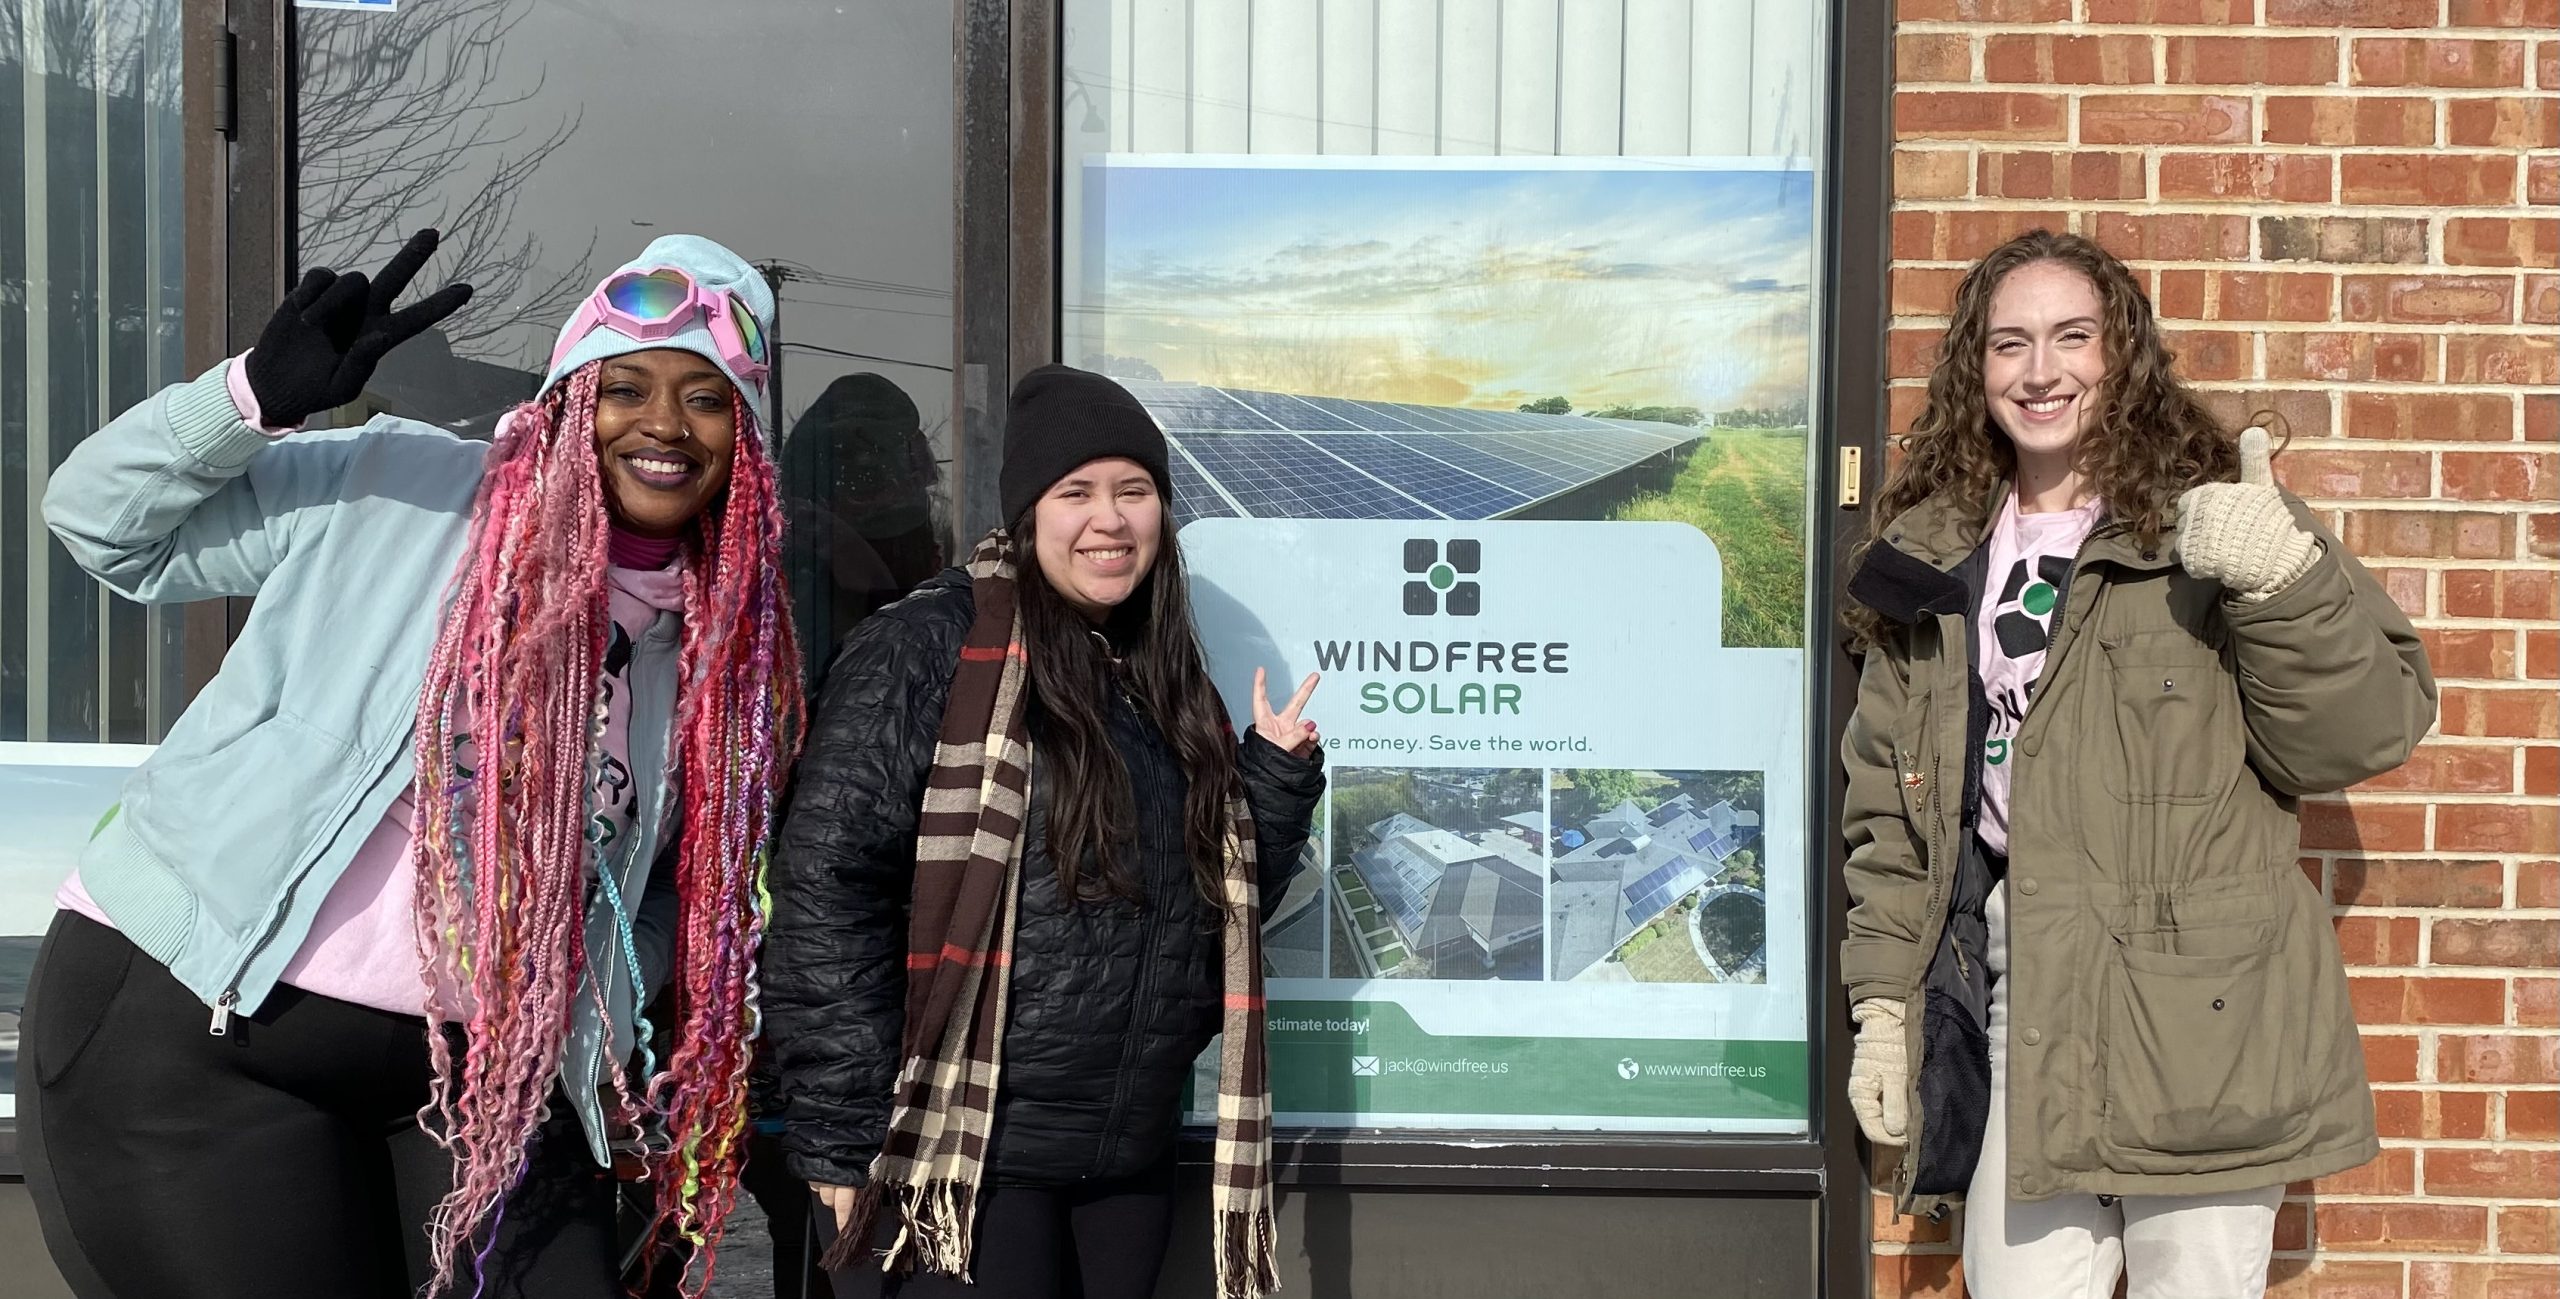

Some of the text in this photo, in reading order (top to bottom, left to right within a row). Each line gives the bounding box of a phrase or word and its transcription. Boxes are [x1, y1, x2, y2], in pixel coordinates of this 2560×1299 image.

[1313, 640, 1569, 673] WINDFREE
[1359, 682, 1522, 715] SOLAR
[1319, 735, 1593, 754] ve money. Save the world.
[1267, 1016, 1370, 1035] stimate today!
[1383, 1056, 1509, 1076] jack@windfree.us
[1644, 1061, 1767, 1079] www.windfree.us
